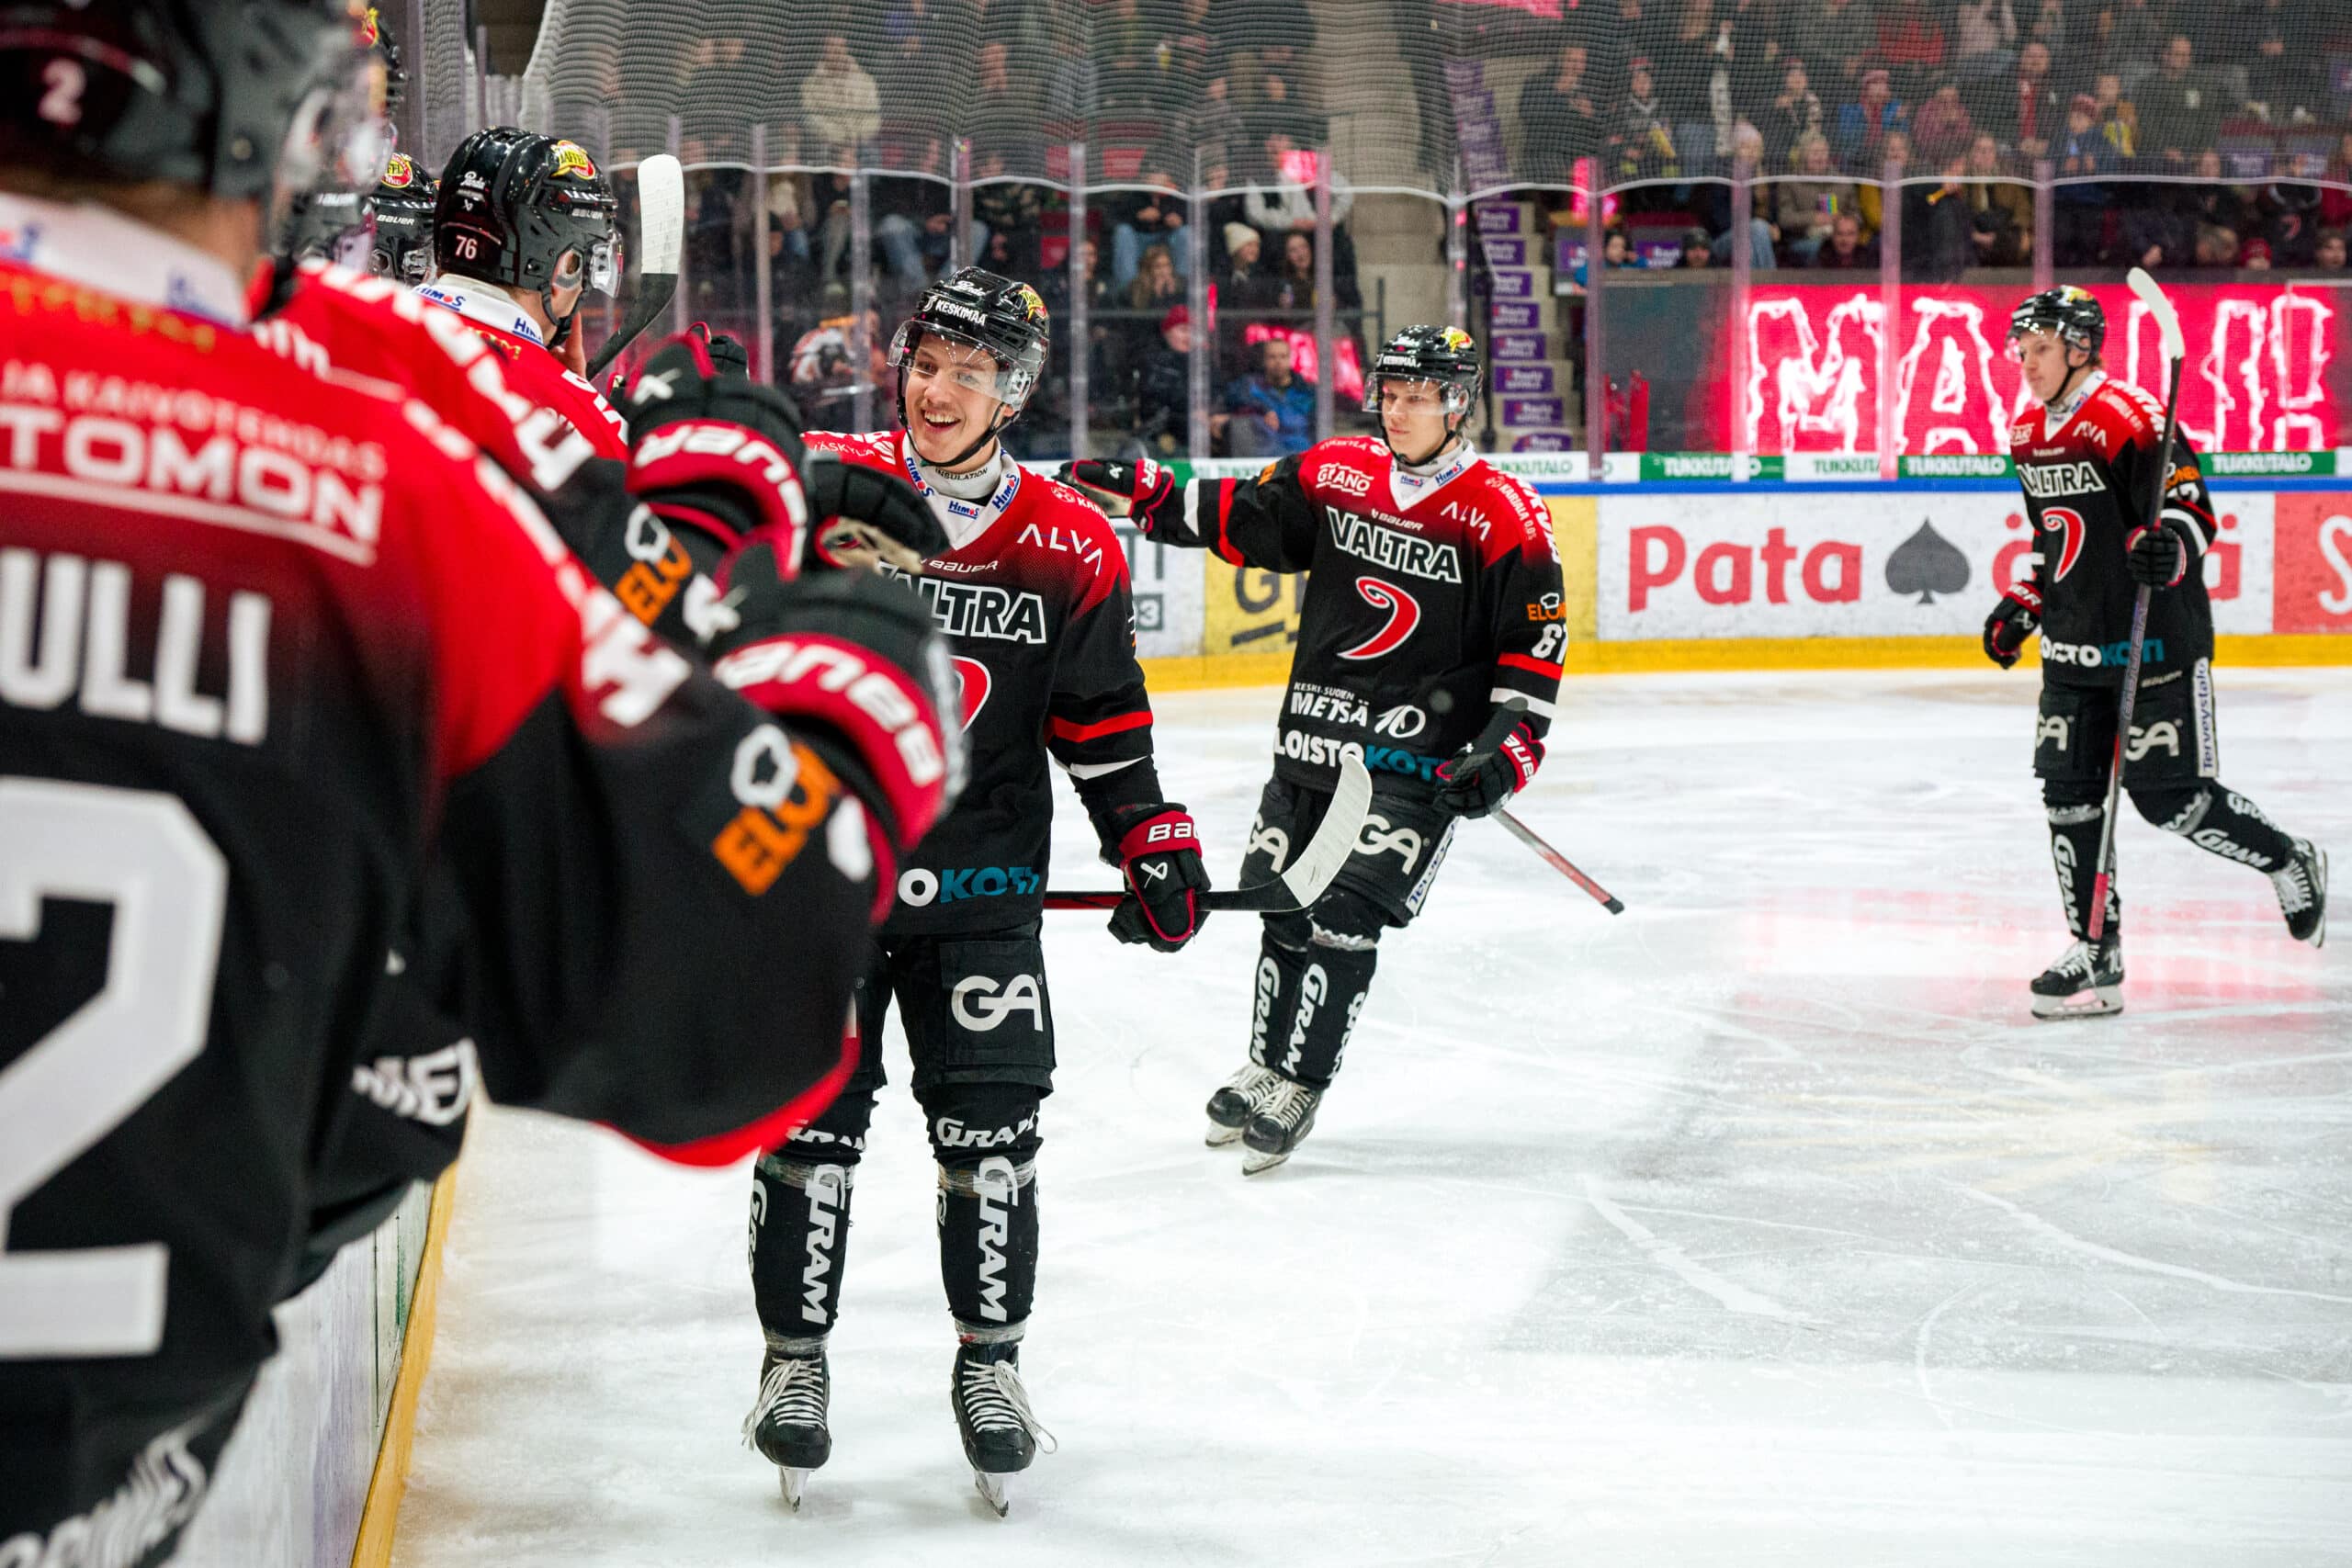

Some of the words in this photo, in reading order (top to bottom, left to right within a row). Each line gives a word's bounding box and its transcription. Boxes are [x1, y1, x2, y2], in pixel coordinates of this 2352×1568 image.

[39, 58, 85, 126] 2
[376, 214, 415, 226] BAUER
[455, 235, 478, 260] 76
[934, 299, 988, 326] KESKIMAA
[934, 467, 989, 480] INSULATION
[1664, 456, 1761, 477] TUKKUTAO
[1907, 457, 2007, 477] TUKKUTALO
[2211, 454, 2312, 475] TUKKUTALO
[948, 501, 979, 518] HIMOS
[992, 473, 1018, 510] HIMOS
[928, 558, 999, 573] BAUER
[1016, 523, 1103, 577] ALVA
[1326, 505, 1462, 583] VALTRA
[1628, 525, 1864, 614] Pata
[2195, 662, 2213, 772] Terveystalo
[1273, 728, 1452, 781] LOISTOKOT
[2192, 828, 2273, 868] GRAM
[2053, 833, 2083, 933] GRAM
[951, 975, 1044, 1032] GA
[1249, 955, 1281, 1067] GRAM
[1282, 962, 1329, 1077] GRAM
[936, 1110, 1036, 1147] GRAM
[802, 1163, 846, 1325] GRAM
[972, 1156, 1018, 1323] GRAM
